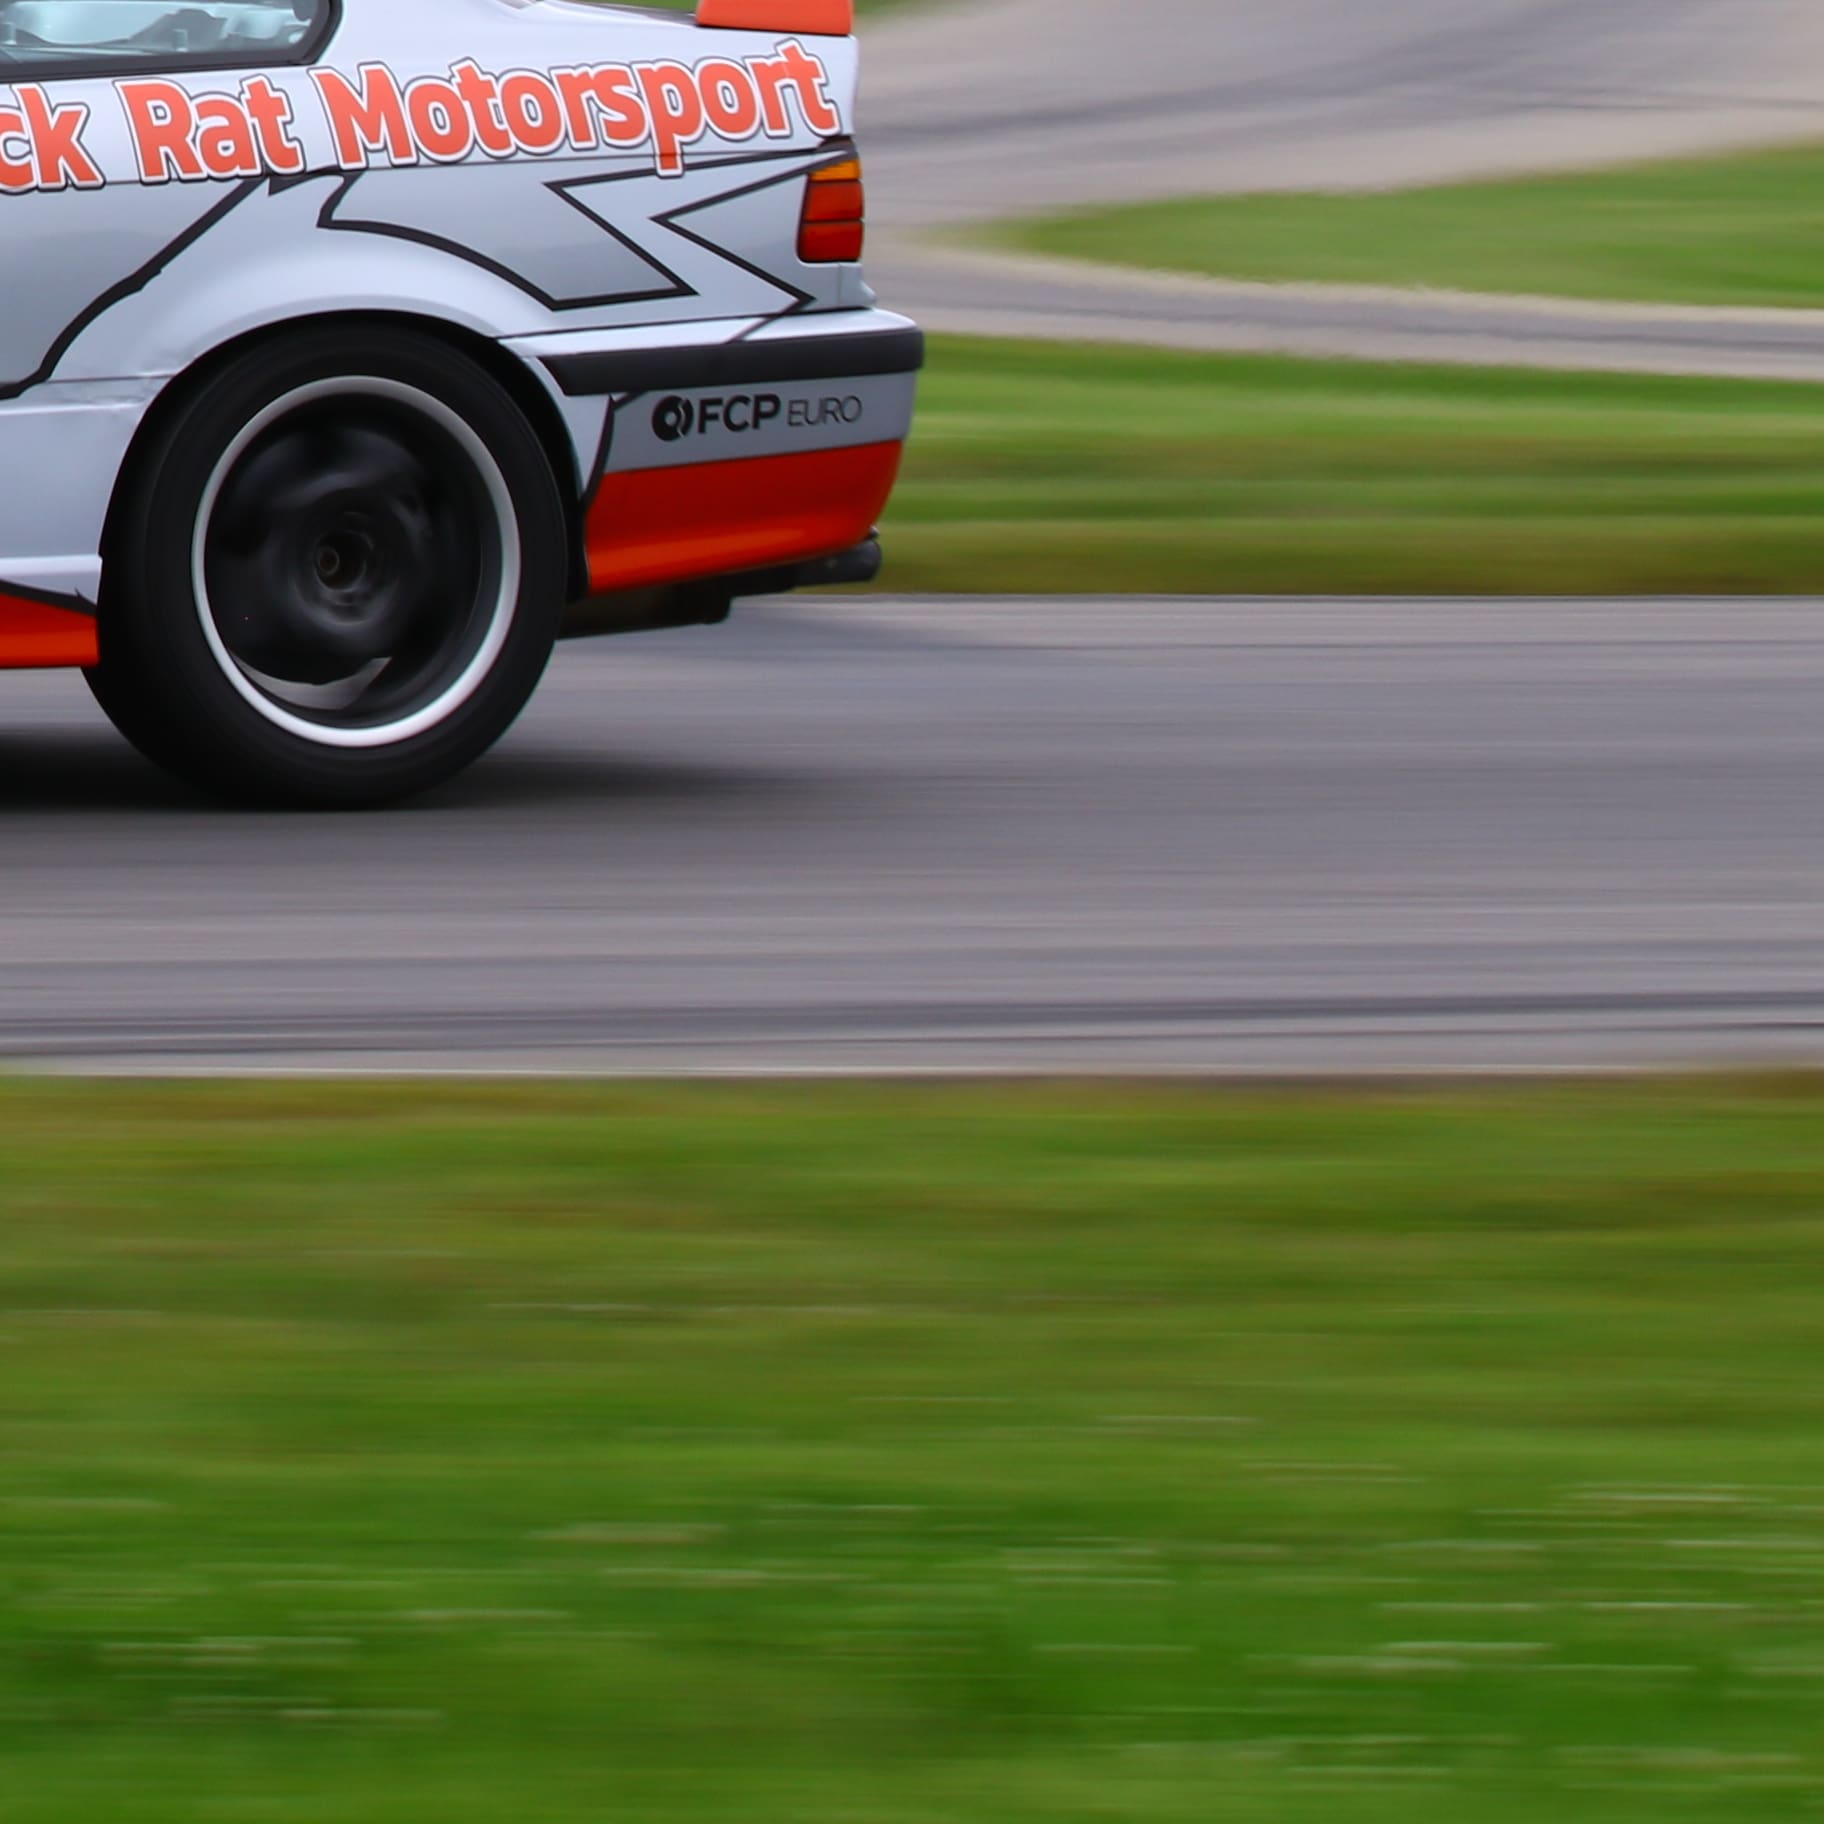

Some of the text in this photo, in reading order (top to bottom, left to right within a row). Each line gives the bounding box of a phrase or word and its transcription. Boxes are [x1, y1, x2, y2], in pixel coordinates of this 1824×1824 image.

[114, 74, 303, 184] Rat
[309, 39, 841, 177] Motorsport
[697, 393, 863, 435] FCP EURO
